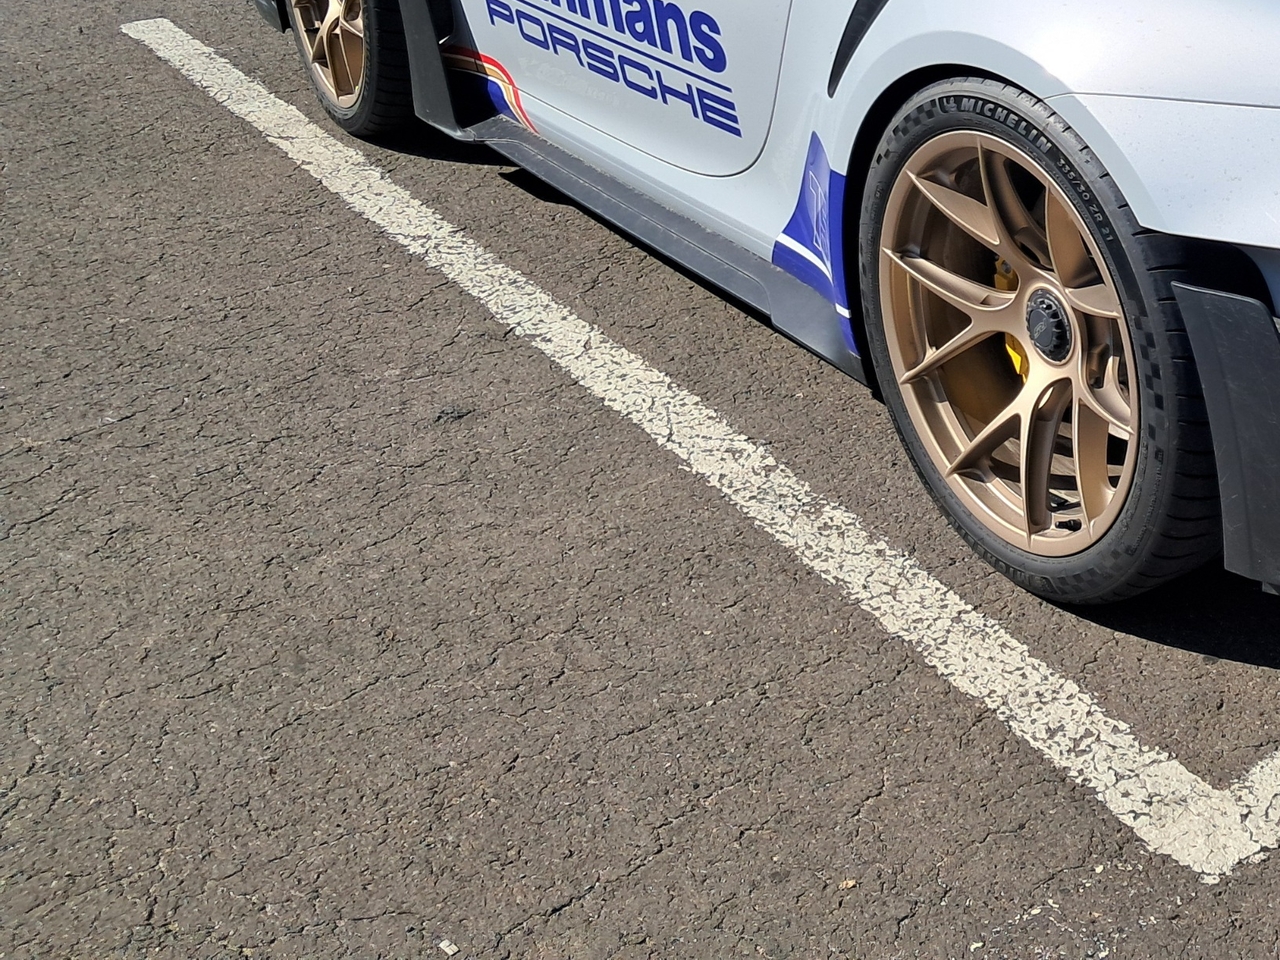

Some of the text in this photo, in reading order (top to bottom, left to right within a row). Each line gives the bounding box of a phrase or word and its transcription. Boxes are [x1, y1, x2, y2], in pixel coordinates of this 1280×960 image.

[960, 97, 1053, 155] MICHELIN
[1056, 158, 1114, 242] 335/30 ZR 21
